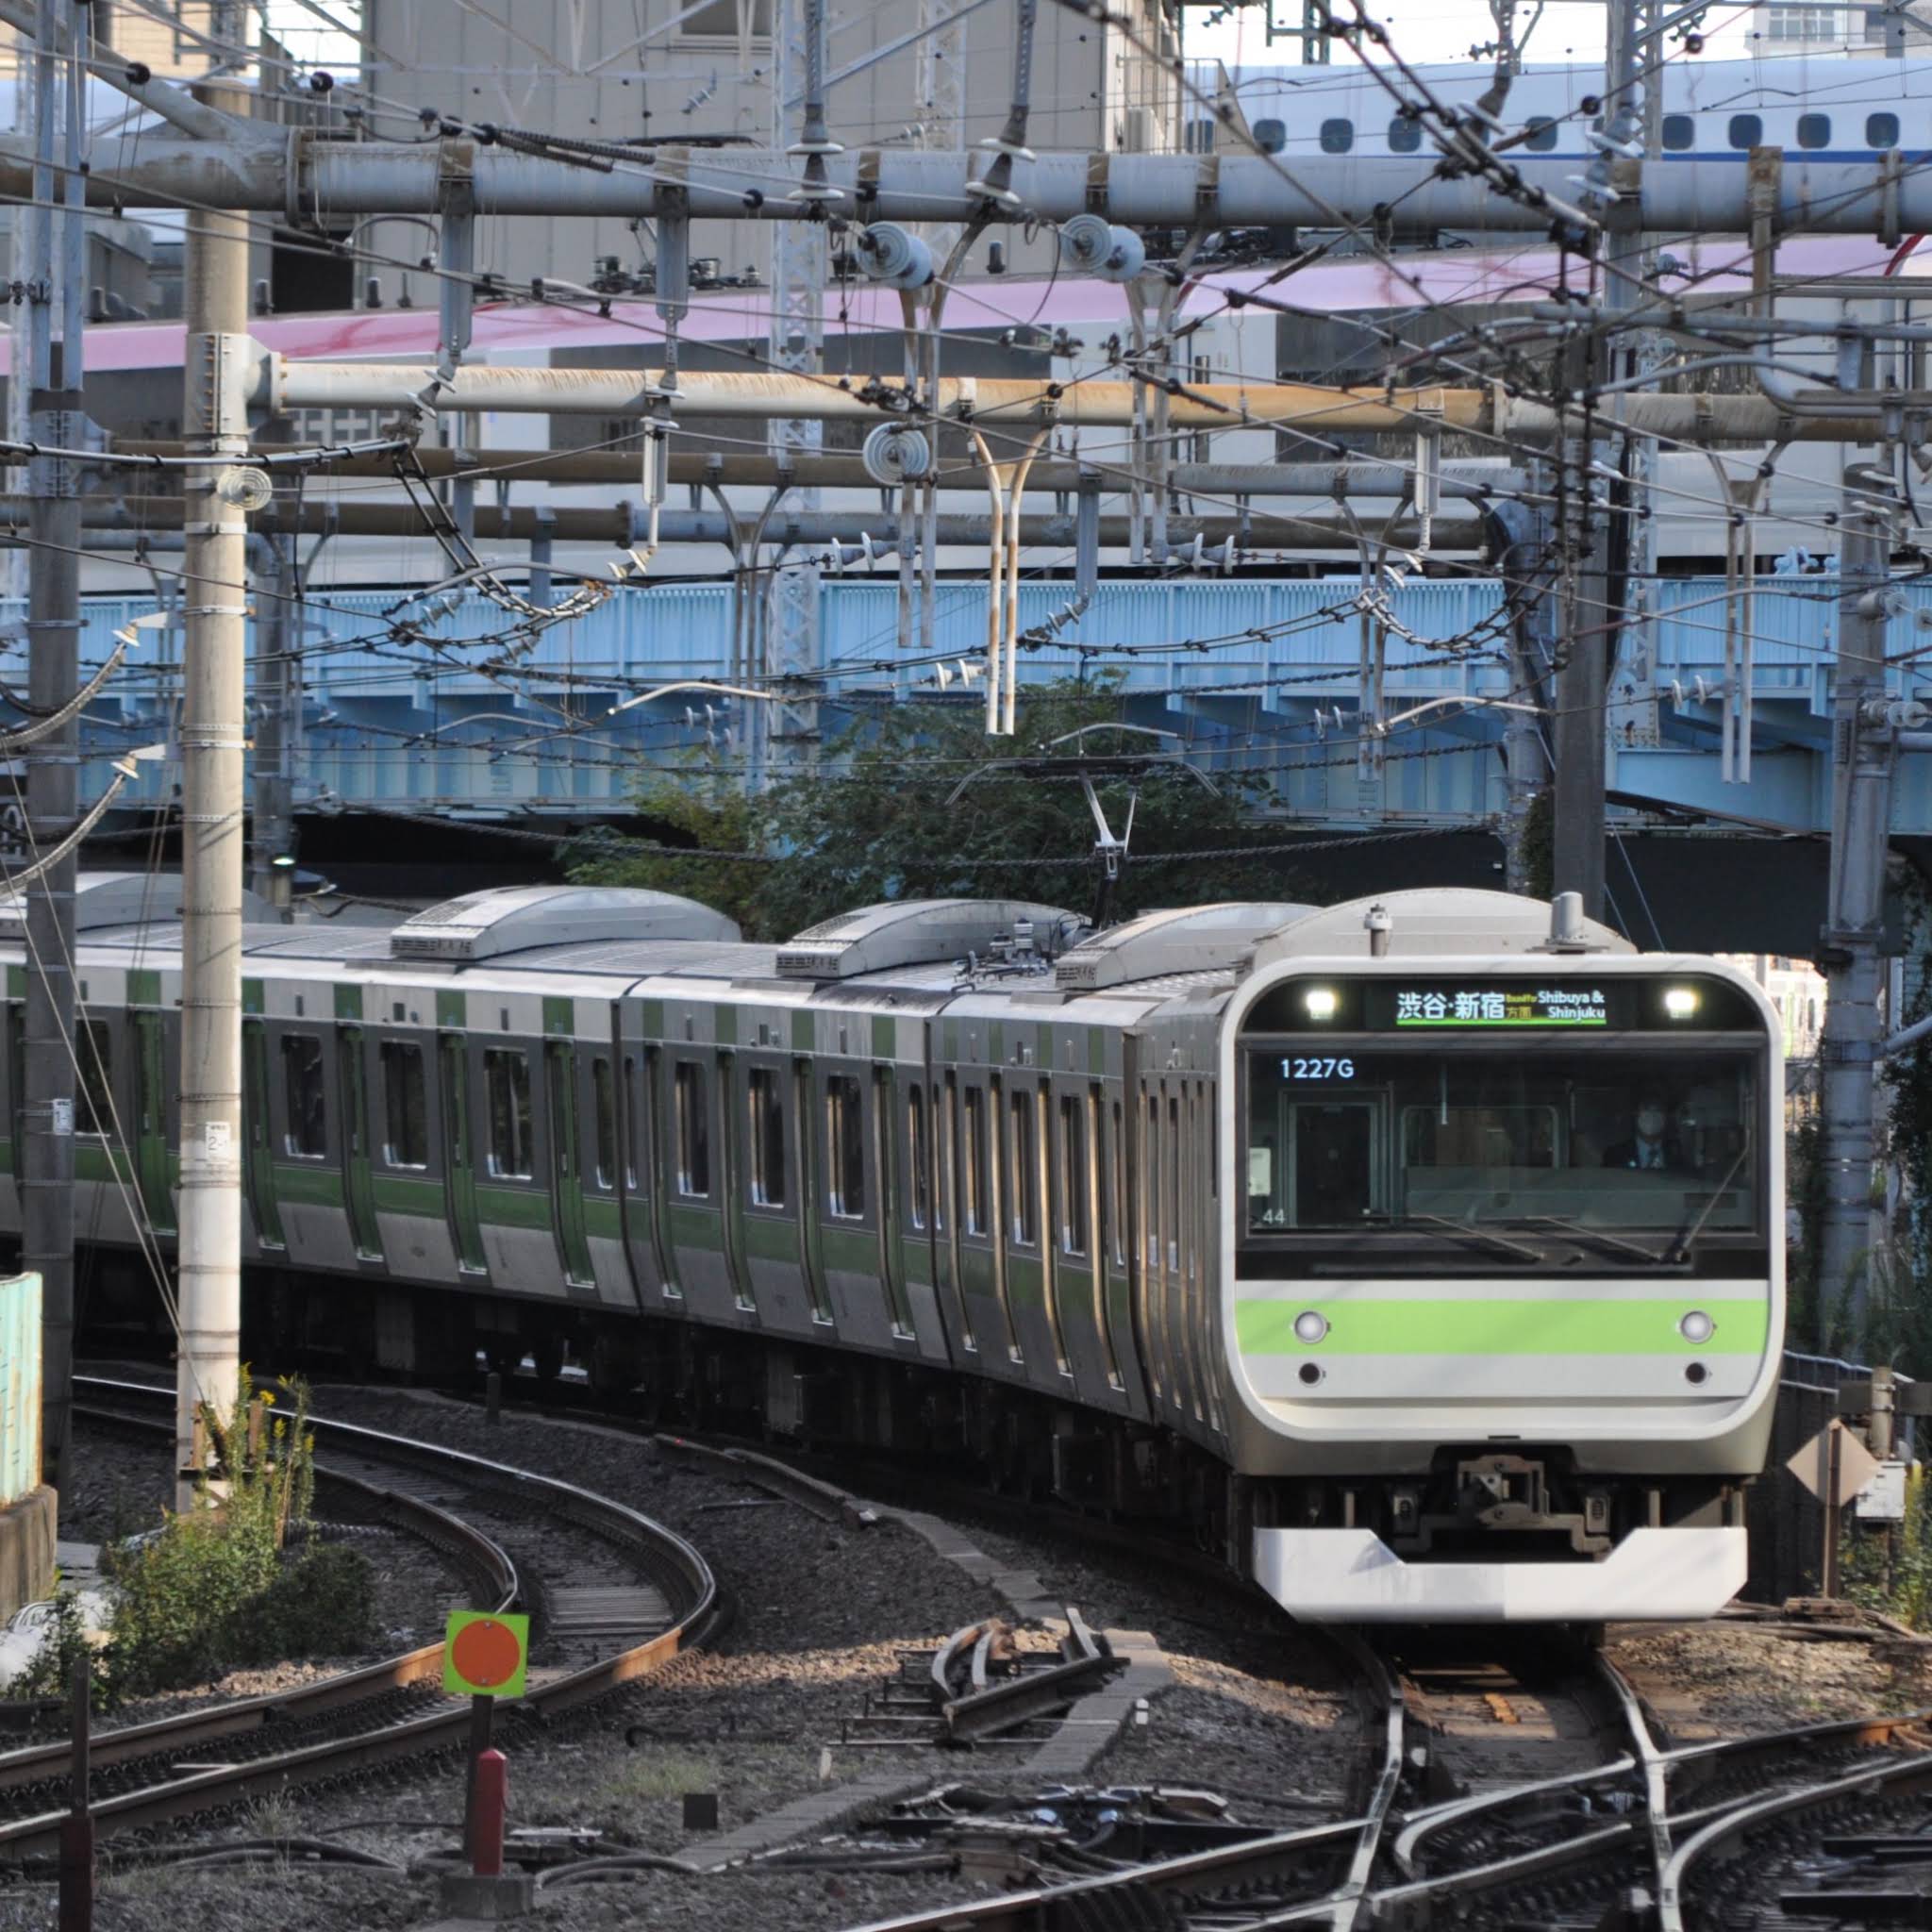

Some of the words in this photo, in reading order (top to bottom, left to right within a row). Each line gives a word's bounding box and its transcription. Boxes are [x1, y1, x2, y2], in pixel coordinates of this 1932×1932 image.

[1538, 991, 1590, 1005] Shibuya
[1591, 990, 1605, 1003] &
[1548, 1007, 1606, 1022] Shinjuku
[1281, 1058, 1355, 1078] 1227G
[1262, 1208, 1285, 1224] 44
